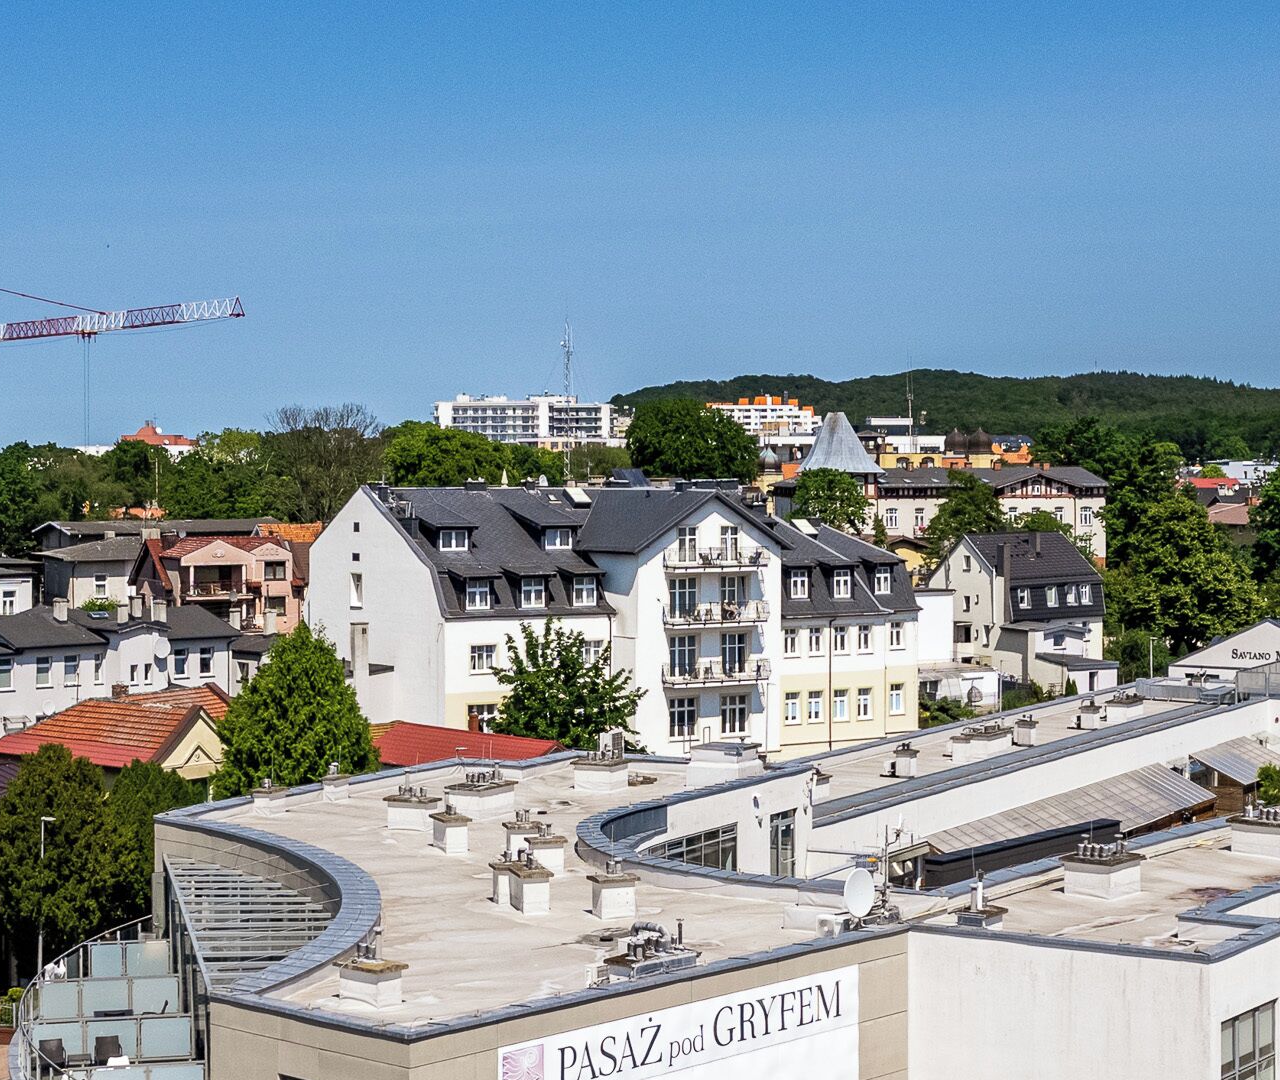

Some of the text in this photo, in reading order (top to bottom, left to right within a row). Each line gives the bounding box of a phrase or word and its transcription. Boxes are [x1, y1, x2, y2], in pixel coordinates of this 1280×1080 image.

[1231, 648, 1271, 661] SAVIANO
[668, 1024, 705, 1067] pod
[713, 980, 842, 1047] GRYFEM
